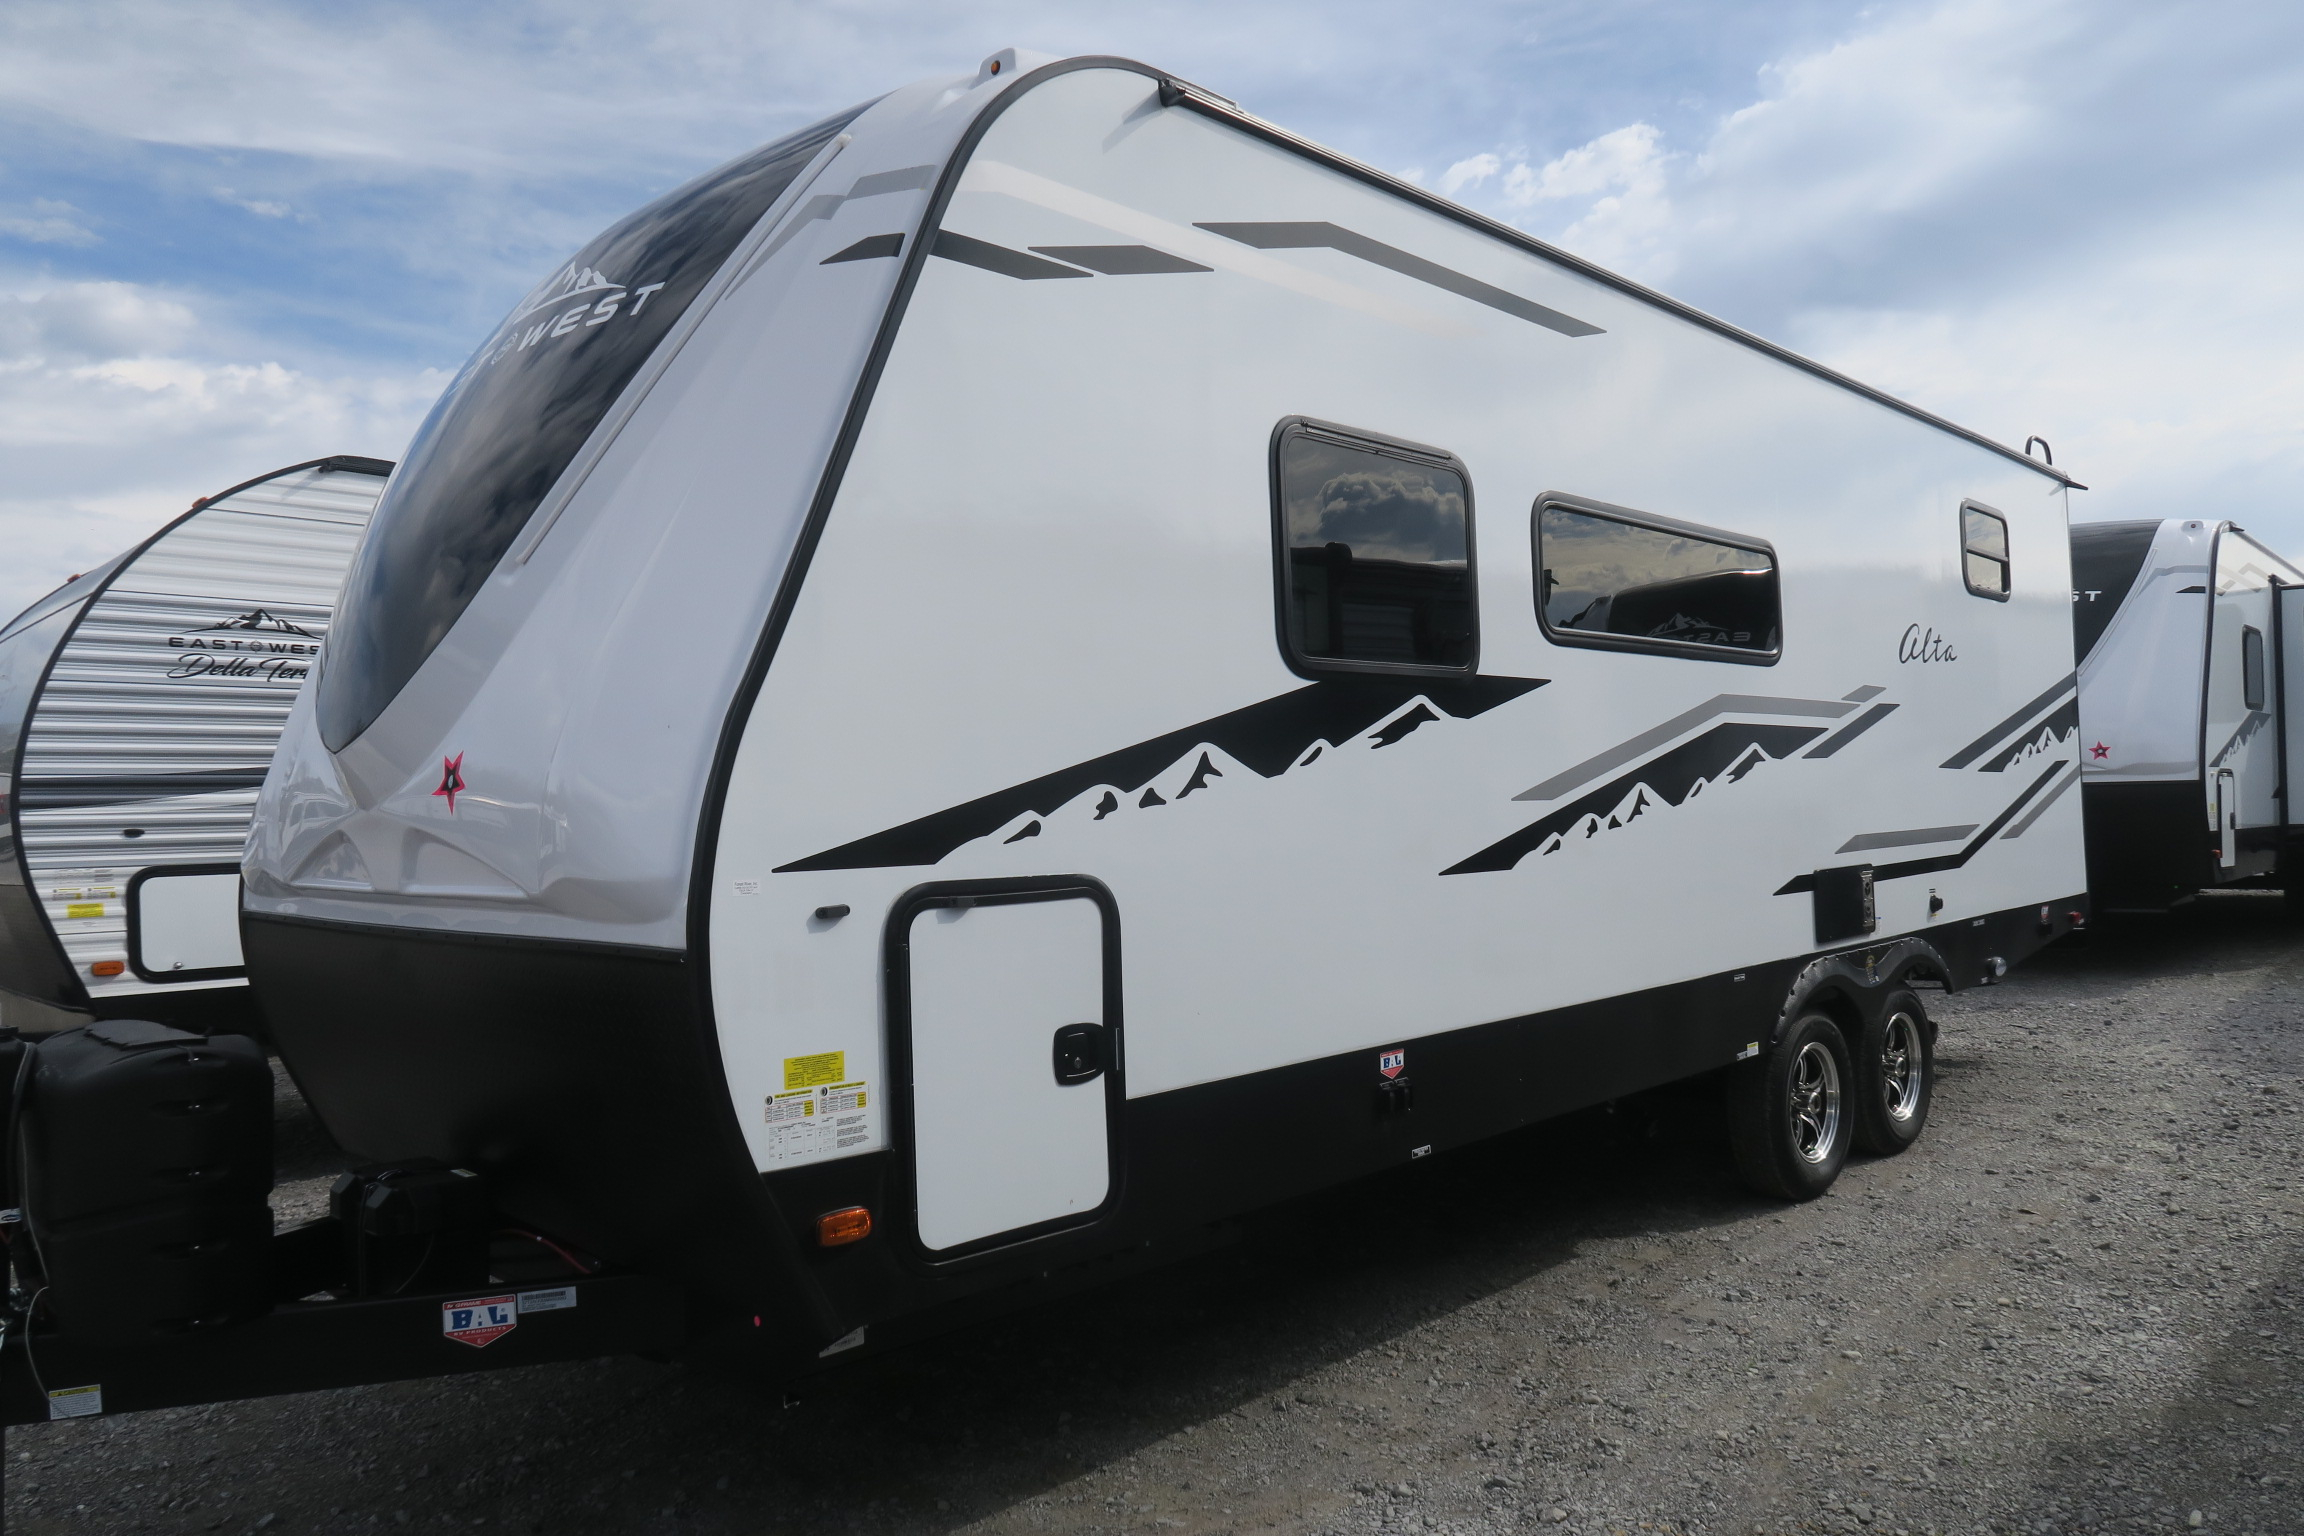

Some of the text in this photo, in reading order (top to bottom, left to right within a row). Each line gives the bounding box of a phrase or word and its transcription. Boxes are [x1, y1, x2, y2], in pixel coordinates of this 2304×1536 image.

[517, 281, 666, 352] WEST
[168, 637, 243, 651] EAST
[1898, 622, 1958, 664] Alta
[166, 652, 259, 679] Della
[452, 1305, 508, 1330] BAL
